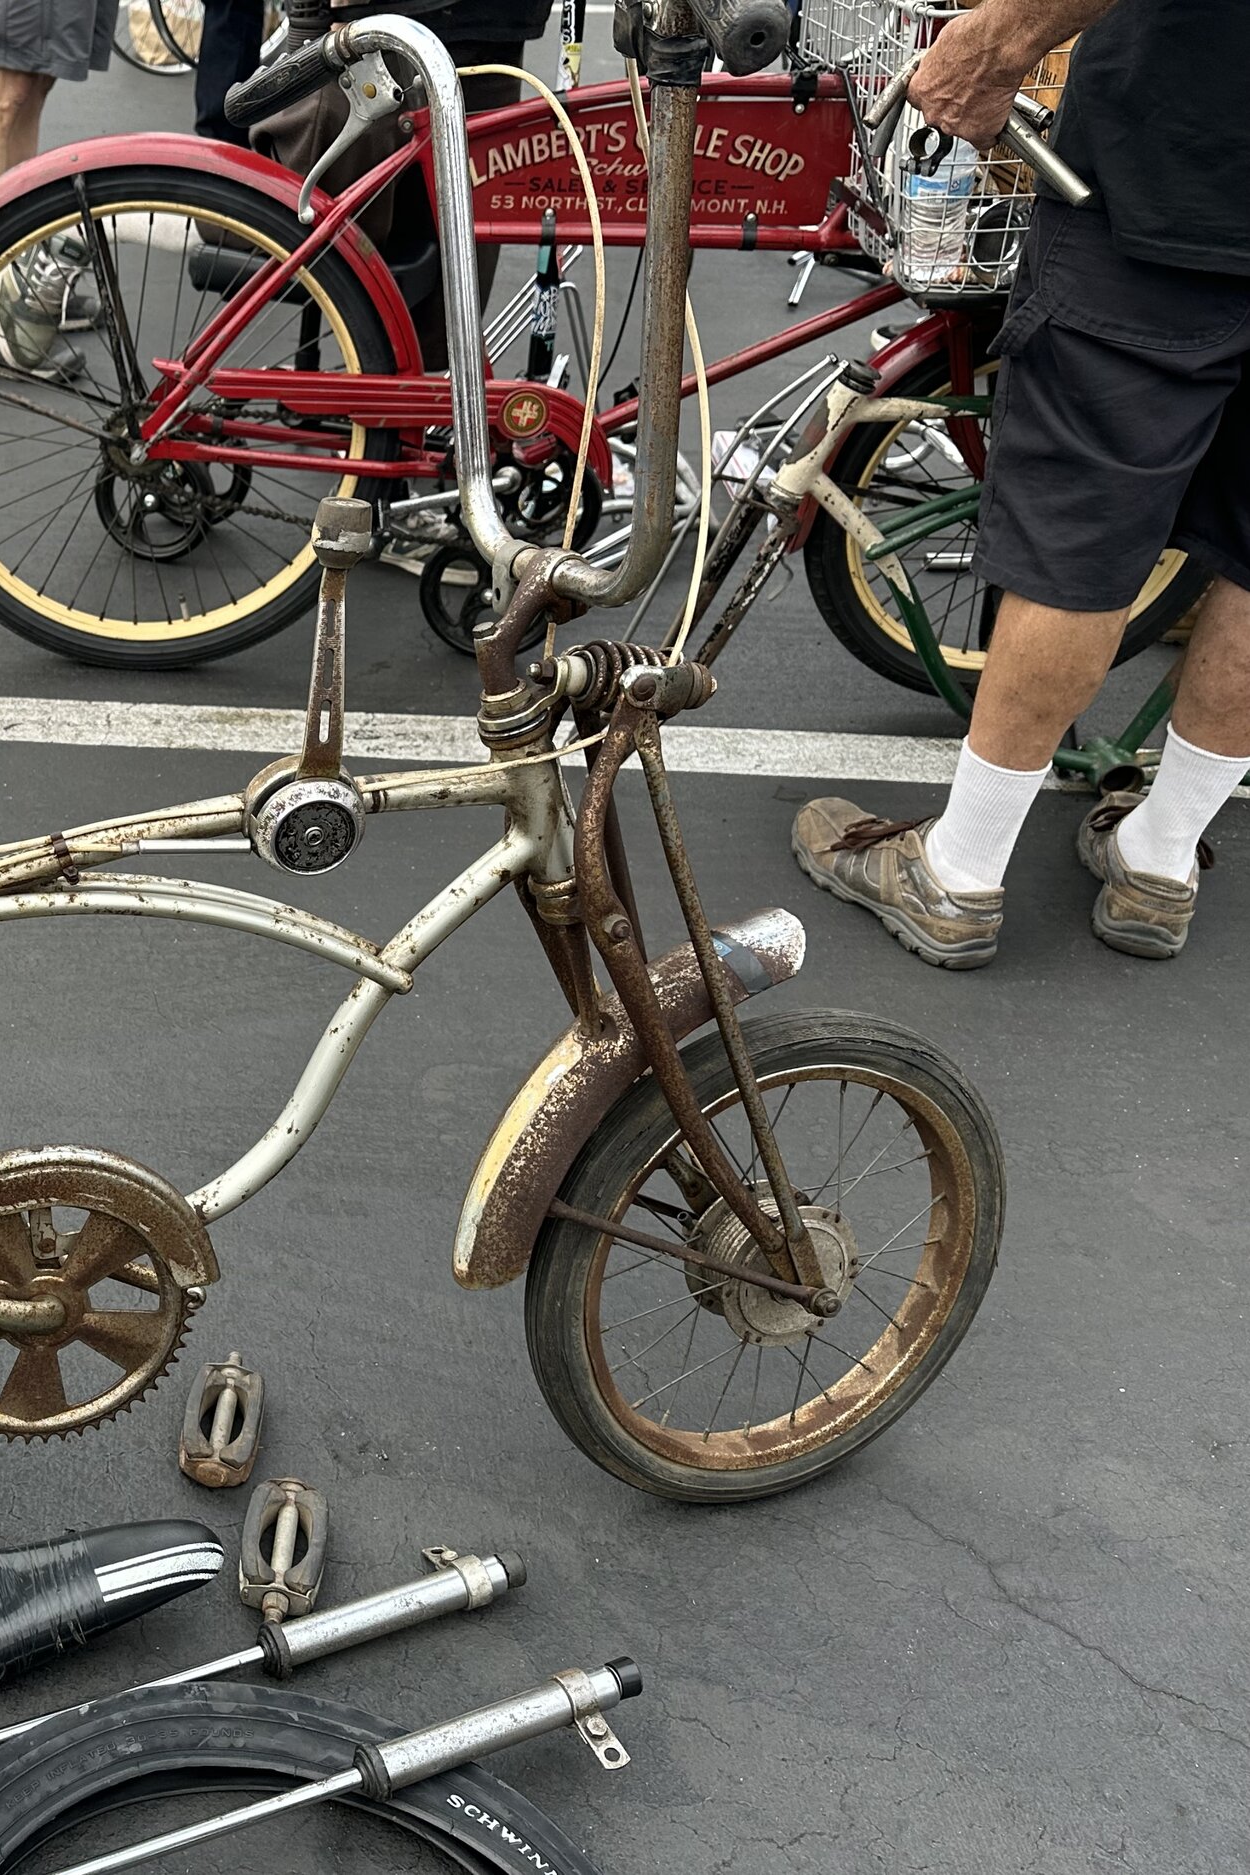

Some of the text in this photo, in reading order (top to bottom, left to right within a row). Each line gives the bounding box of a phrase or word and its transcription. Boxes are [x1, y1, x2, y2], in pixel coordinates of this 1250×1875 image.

[728, 134, 805, 182] SHOP
[490, 195, 515, 209] 53
[521, 195, 587, 211] NORTH
[625, 197, 749, 214] CLMONT,
[755, 199, 789, 215] N.H.
[529, 177, 588, 193] SALE
[603, 179, 617, 194] &
[46, 1741, 117, 1781] INFLATED
[190, 1728, 255, 1739] POUNDS
[446, 1793, 558, 1875] SCHWIN
